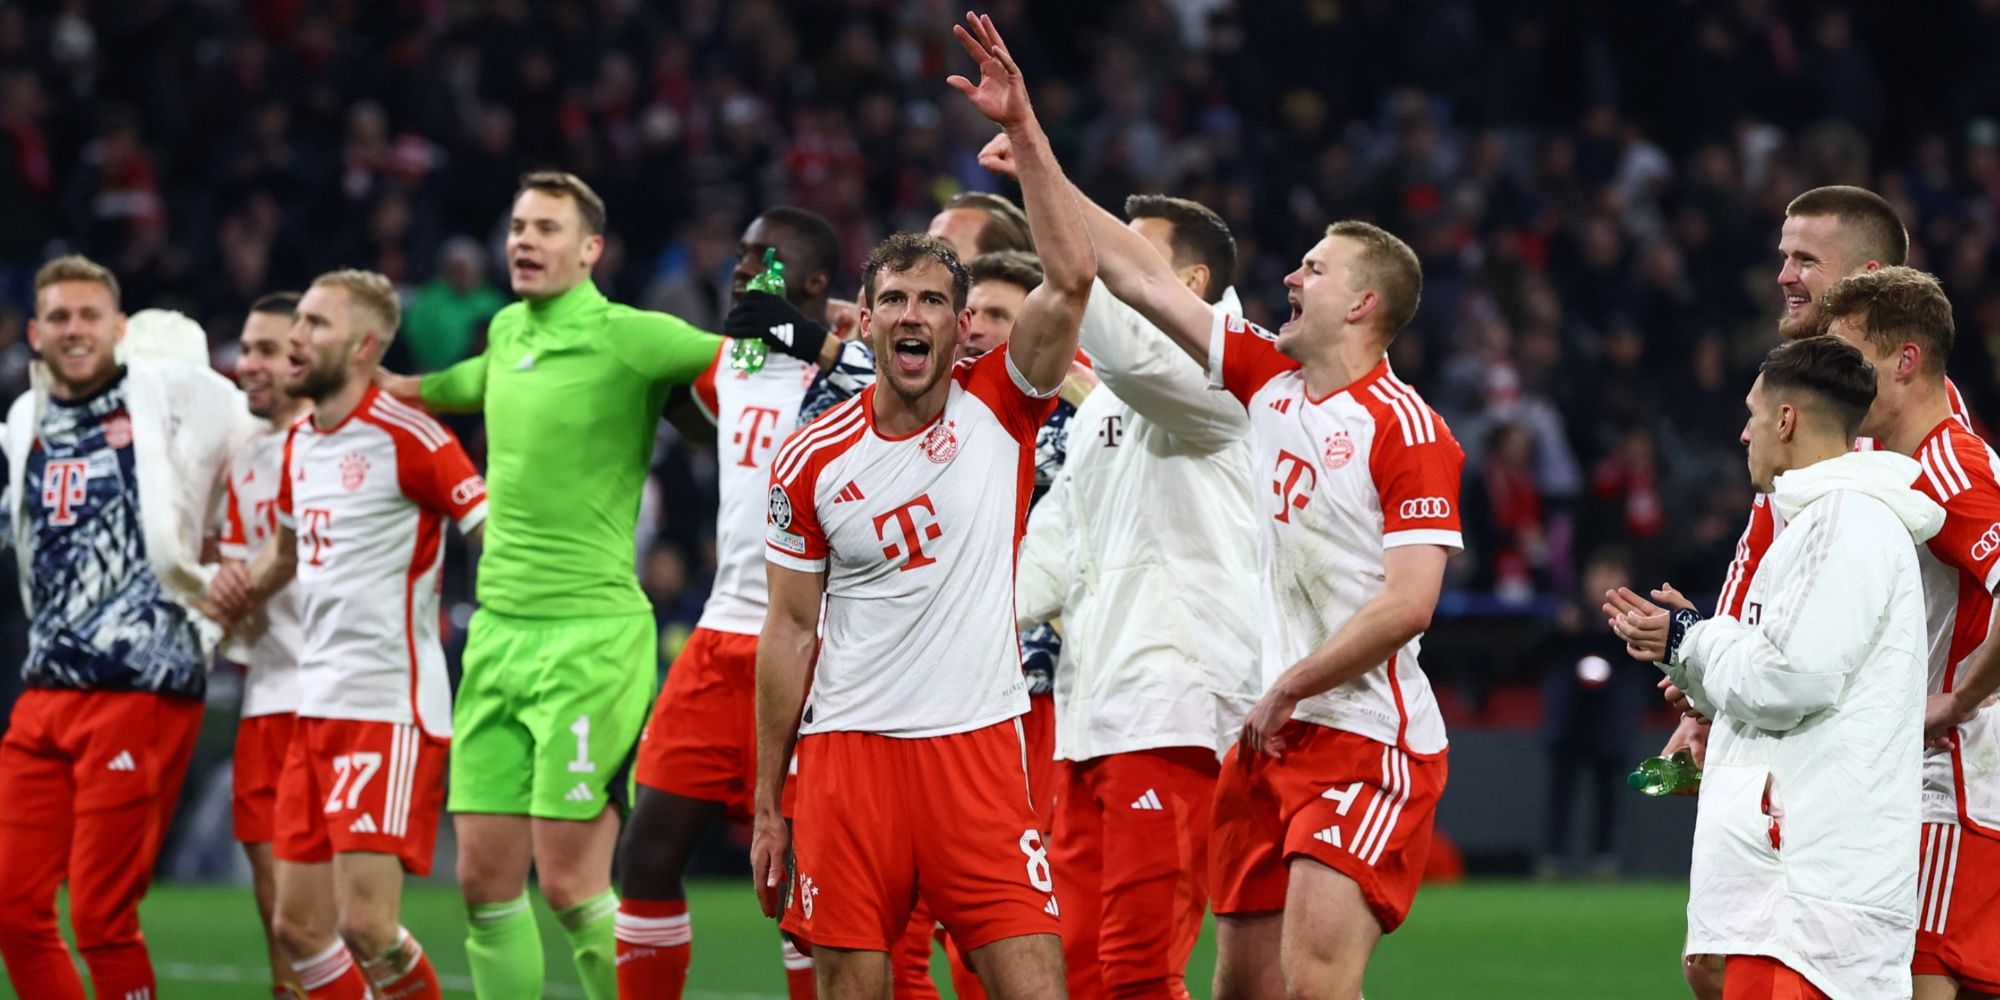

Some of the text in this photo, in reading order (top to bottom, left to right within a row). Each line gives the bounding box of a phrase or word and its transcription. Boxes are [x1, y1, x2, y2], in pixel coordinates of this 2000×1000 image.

[734, 406, 780, 468] T
[1099, 415, 1122, 448] T
[43, 459, 88, 526] T
[1273, 448, 1317, 524] T
[303, 508, 332, 566] T
[872, 492, 943, 572] T
[568, 714, 595, 772] 1
[323, 752, 383, 813] 27
[1321, 781, 1364, 816] 4
[1020, 829, 1053, 892] 8
